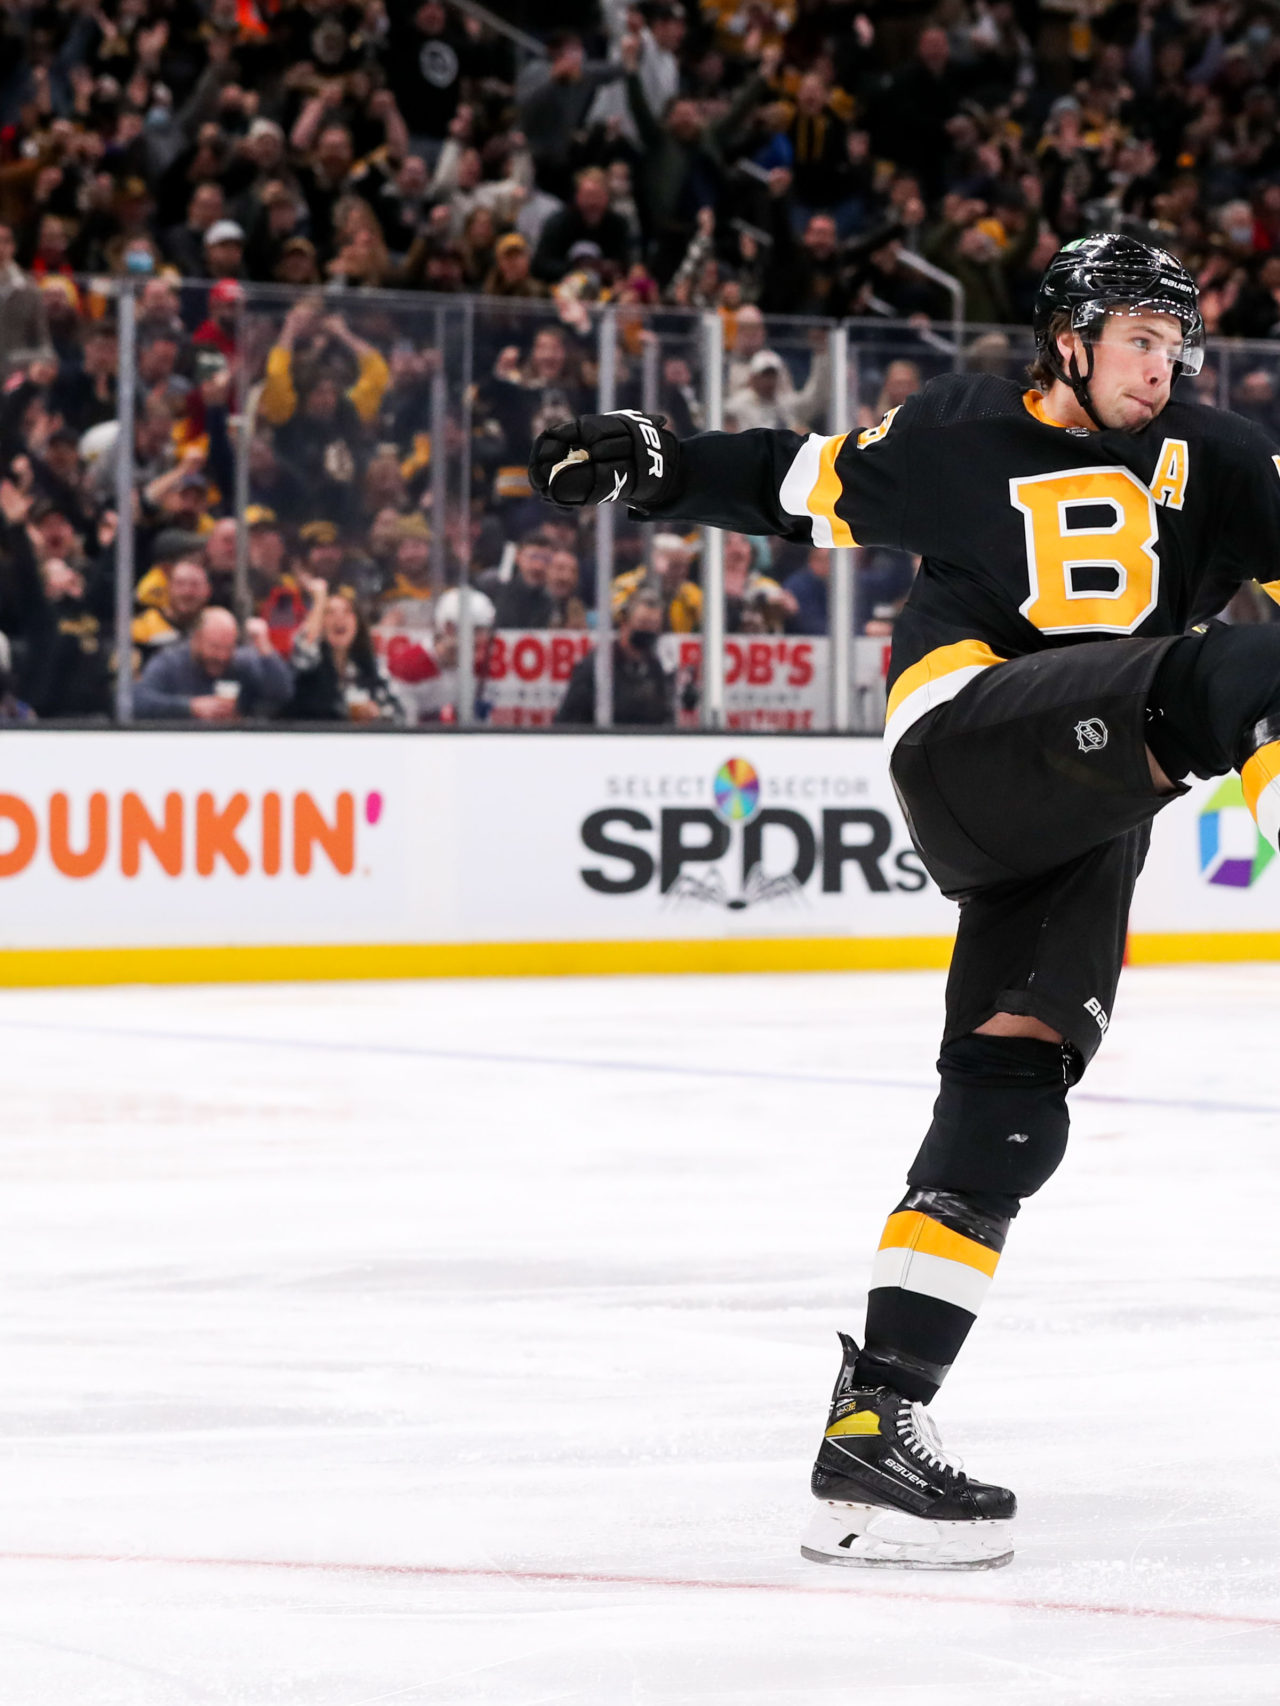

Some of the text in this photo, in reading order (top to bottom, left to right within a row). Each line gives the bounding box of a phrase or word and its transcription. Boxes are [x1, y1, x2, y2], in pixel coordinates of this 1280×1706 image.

[1151, 438, 1189, 511] A
[1009, 465, 1159, 635] B
[607, 775, 870, 799] SELECT SECTOR
[0, 791, 383, 879] DUNKIN'
